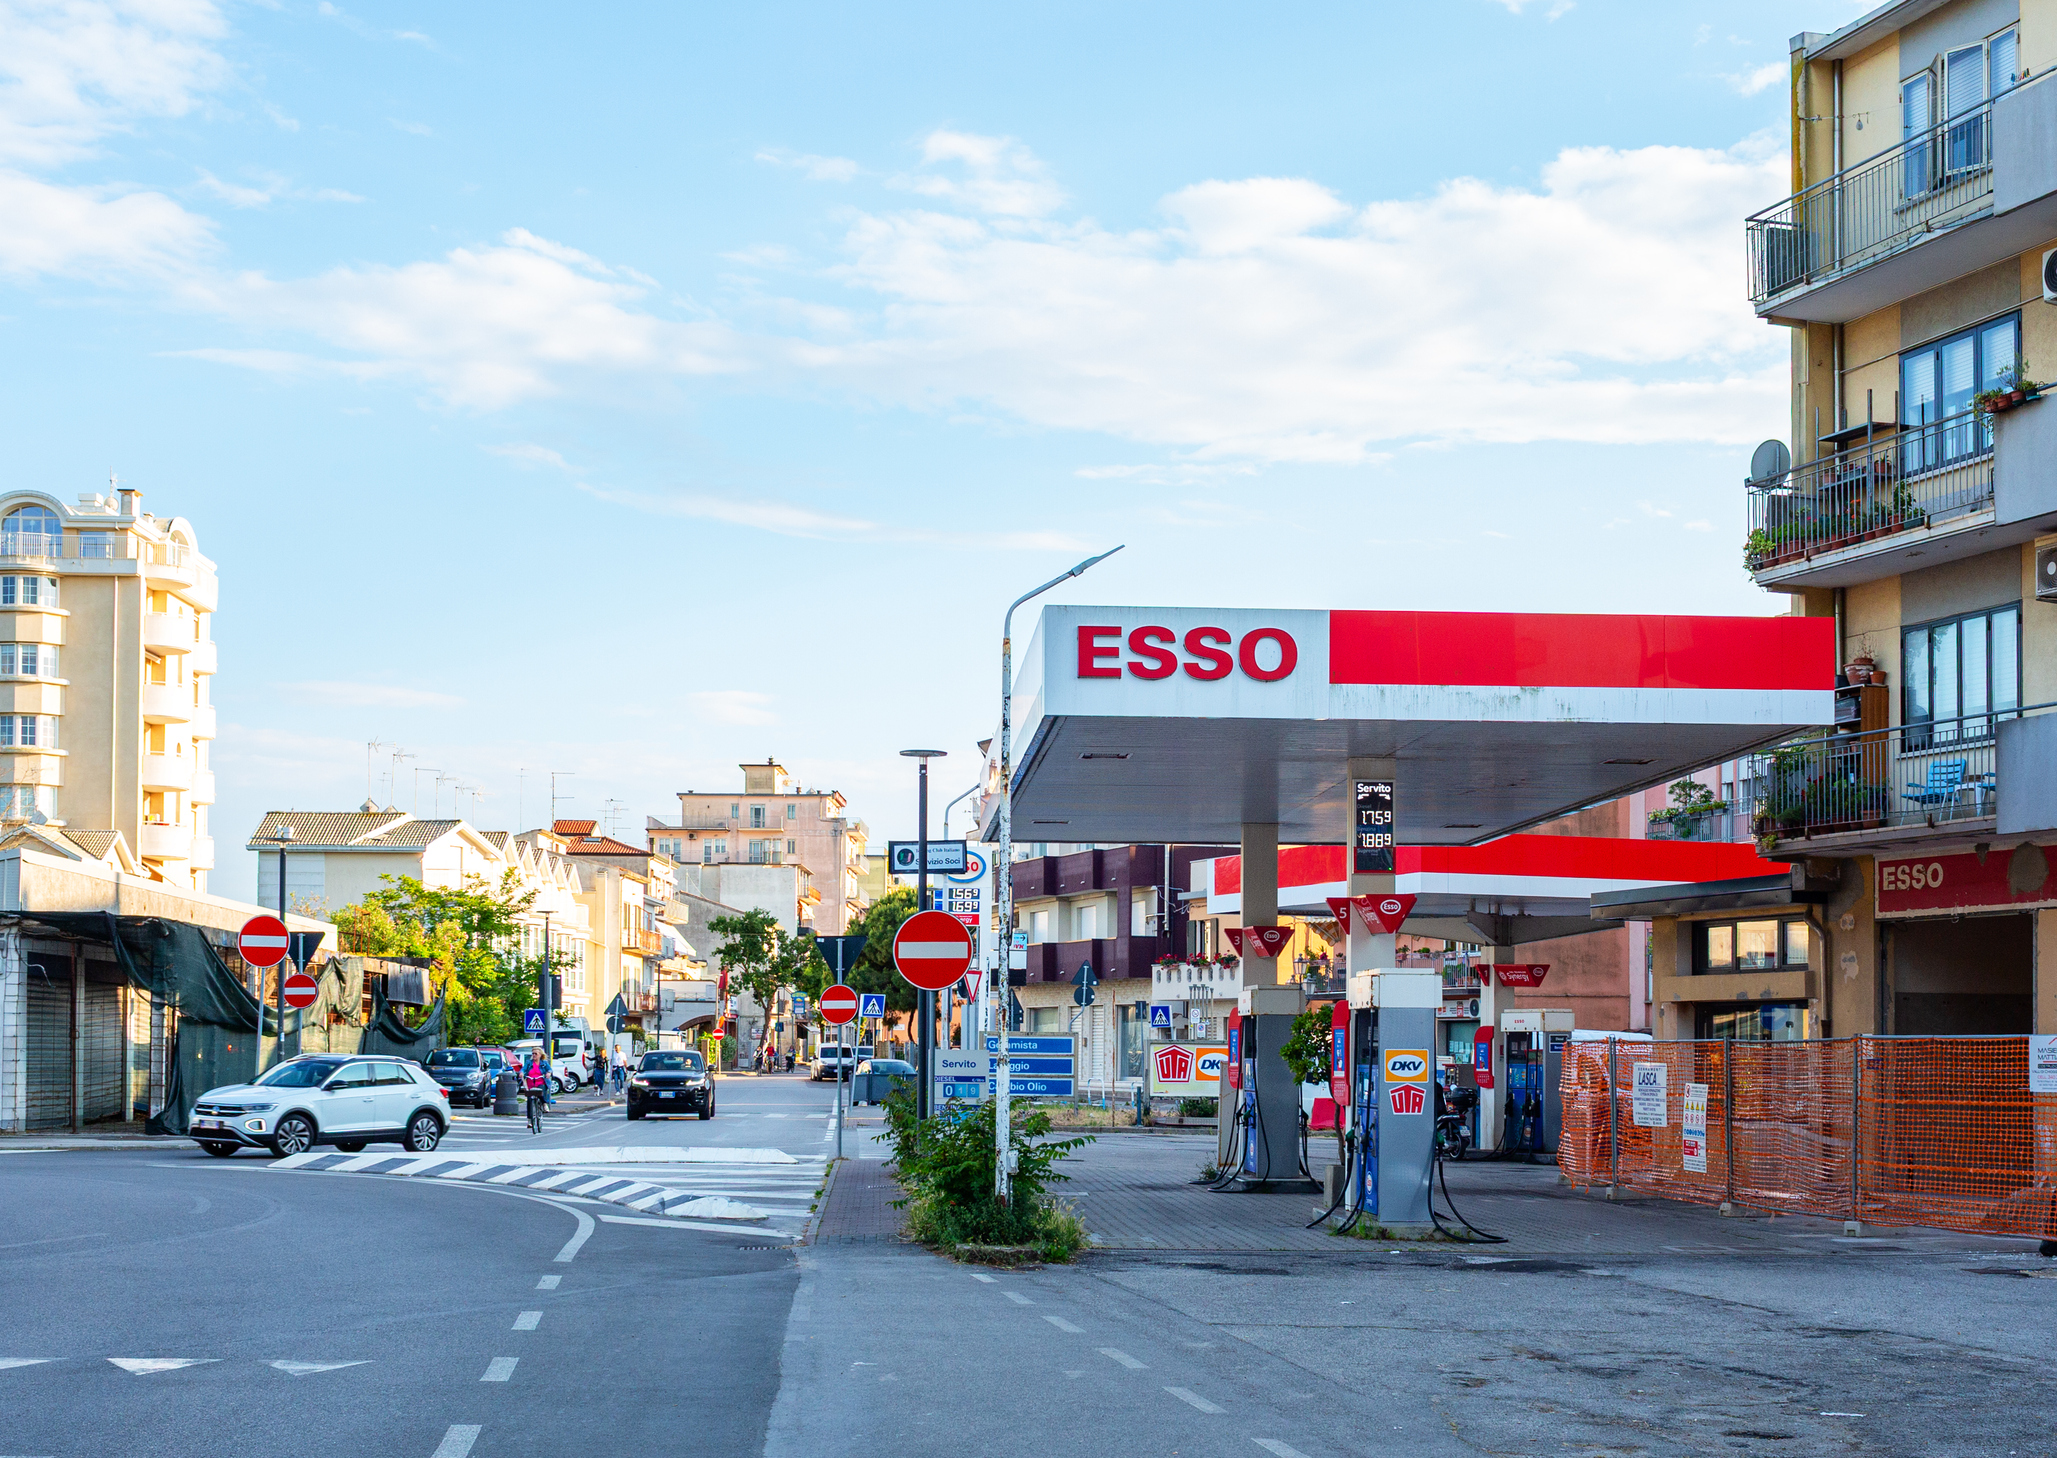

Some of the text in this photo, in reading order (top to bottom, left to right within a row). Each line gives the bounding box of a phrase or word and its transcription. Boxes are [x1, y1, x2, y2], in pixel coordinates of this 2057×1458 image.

[1077, 625, 1298, 682] ESSO
[1357, 783, 1391, 793] Servito
[1882, 862, 1944, 890] ESSO
[1339, 907, 1347, 919] 5
[1234, 936, 1240, 945] 3
[942, 1060, 976, 1068] Servito
[1158, 1048, 1190, 1079] UTA
[1201, 1060, 1220, 1070] DK
[1391, 1061, 1423, 1071] DKV
[1638, 1072, 1657, 1085] LASCA
[1028, 1082, 1047, 1091] Olio
[1390, 1084, 1425, 1113] UTA
